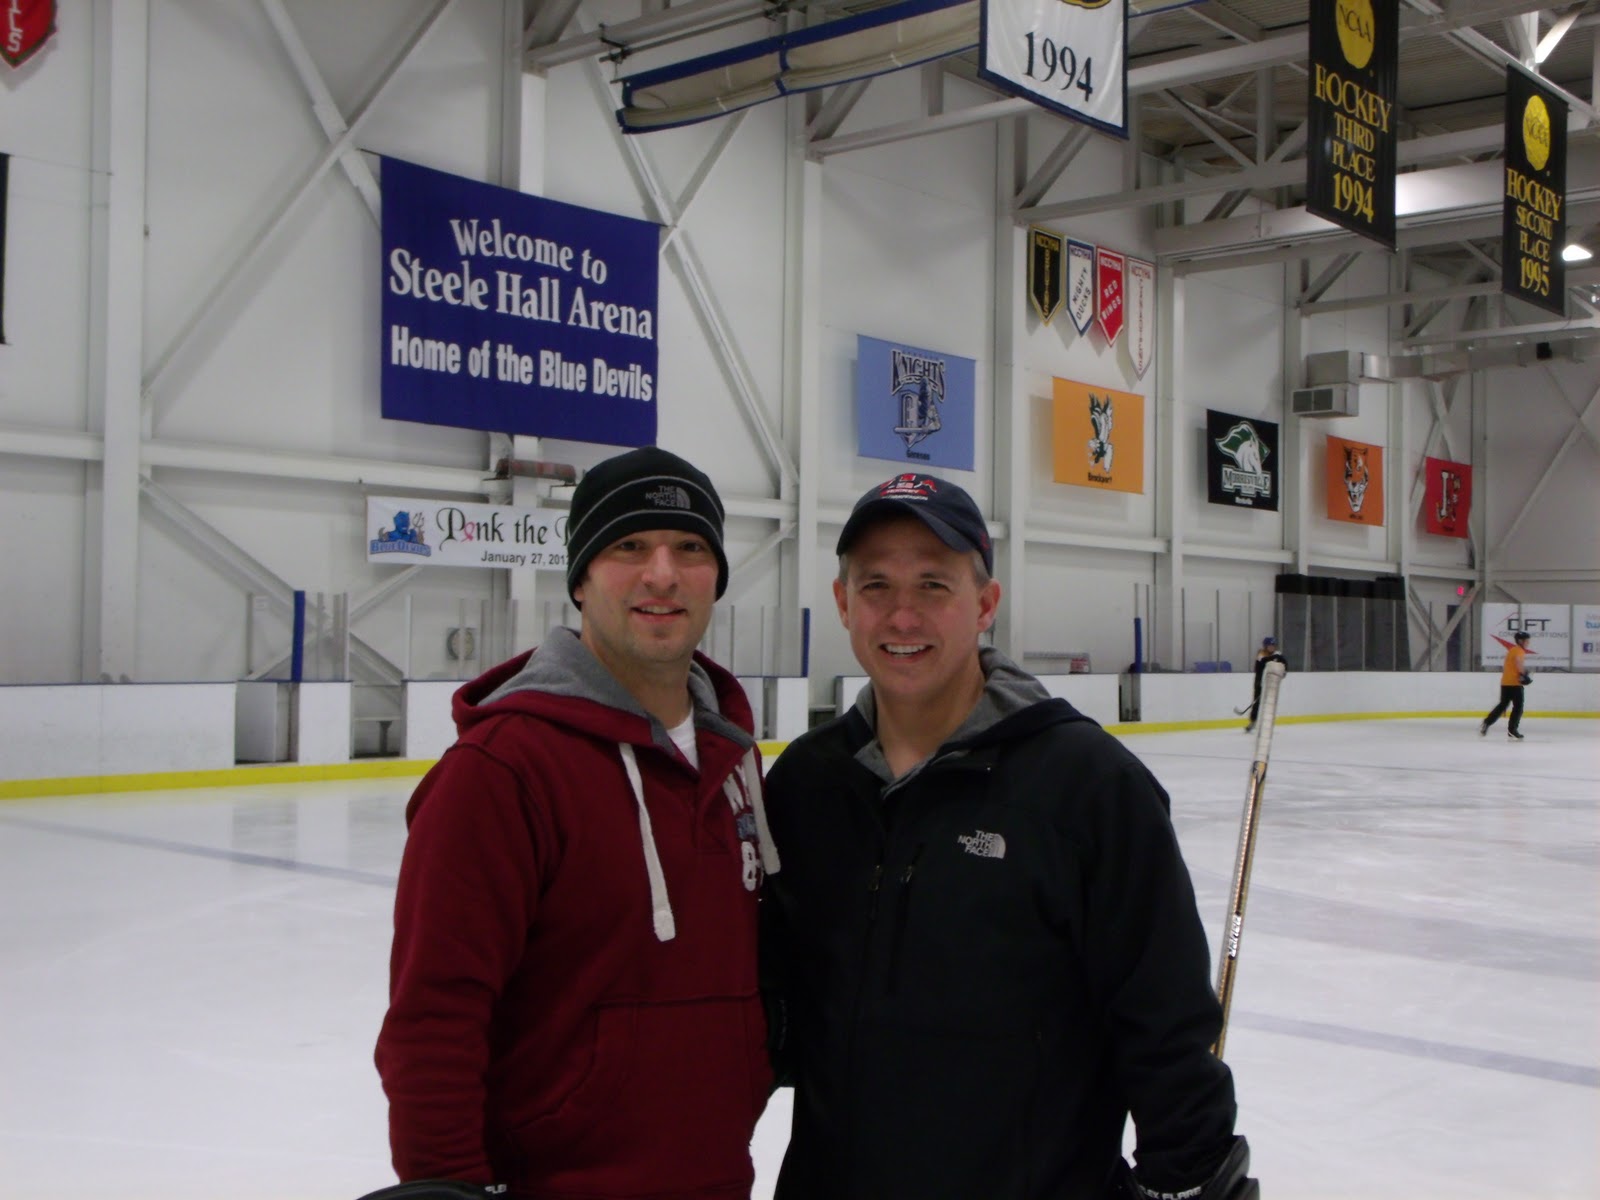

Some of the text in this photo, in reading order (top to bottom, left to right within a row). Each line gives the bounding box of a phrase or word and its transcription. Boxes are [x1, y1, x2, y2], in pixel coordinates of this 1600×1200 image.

[1339, 4, 1372, 43] NCAA
[1023, 31, 1093, 102] 1994
[1315, 63, 1392, 134] HOCKEY
[1334, 112, 1375, 153] THIRD
[1332, 140, 1375, 182] PLACE
[1333, 172, 1375, 223] 1994
[1506, 167, 1563, 221] HOCKEY
[450, 218, 608, 285] Welcome to
[1519, 230, 1550, 262] PLACE
[390, 248, 653, 340] Steele Hall Arena
[1103, 280, 1119, 299] RED
[1520, 257, 1550, 297] 1995
[1076, 287, 1092, 321] DUCKS
[1101, 295, 1122, 321] WINGS
[391, 325, 652, 402] Home of the Blue Devils
[892, 350, 945, 399] KNIGHTS
[645, 492, 677, 500] NORTH
[654, 499, 677, 508] FACE
[658, 485, 676, 494] THE
[514, 514, 548, 545] the
[481, 551, 526, 567] January
[531, 553, 546, 567] 27,
[957, 835, 992, 850] NORTH
[964, 845, 990, 857] FACE
[975, 830, 994, 841] THE
